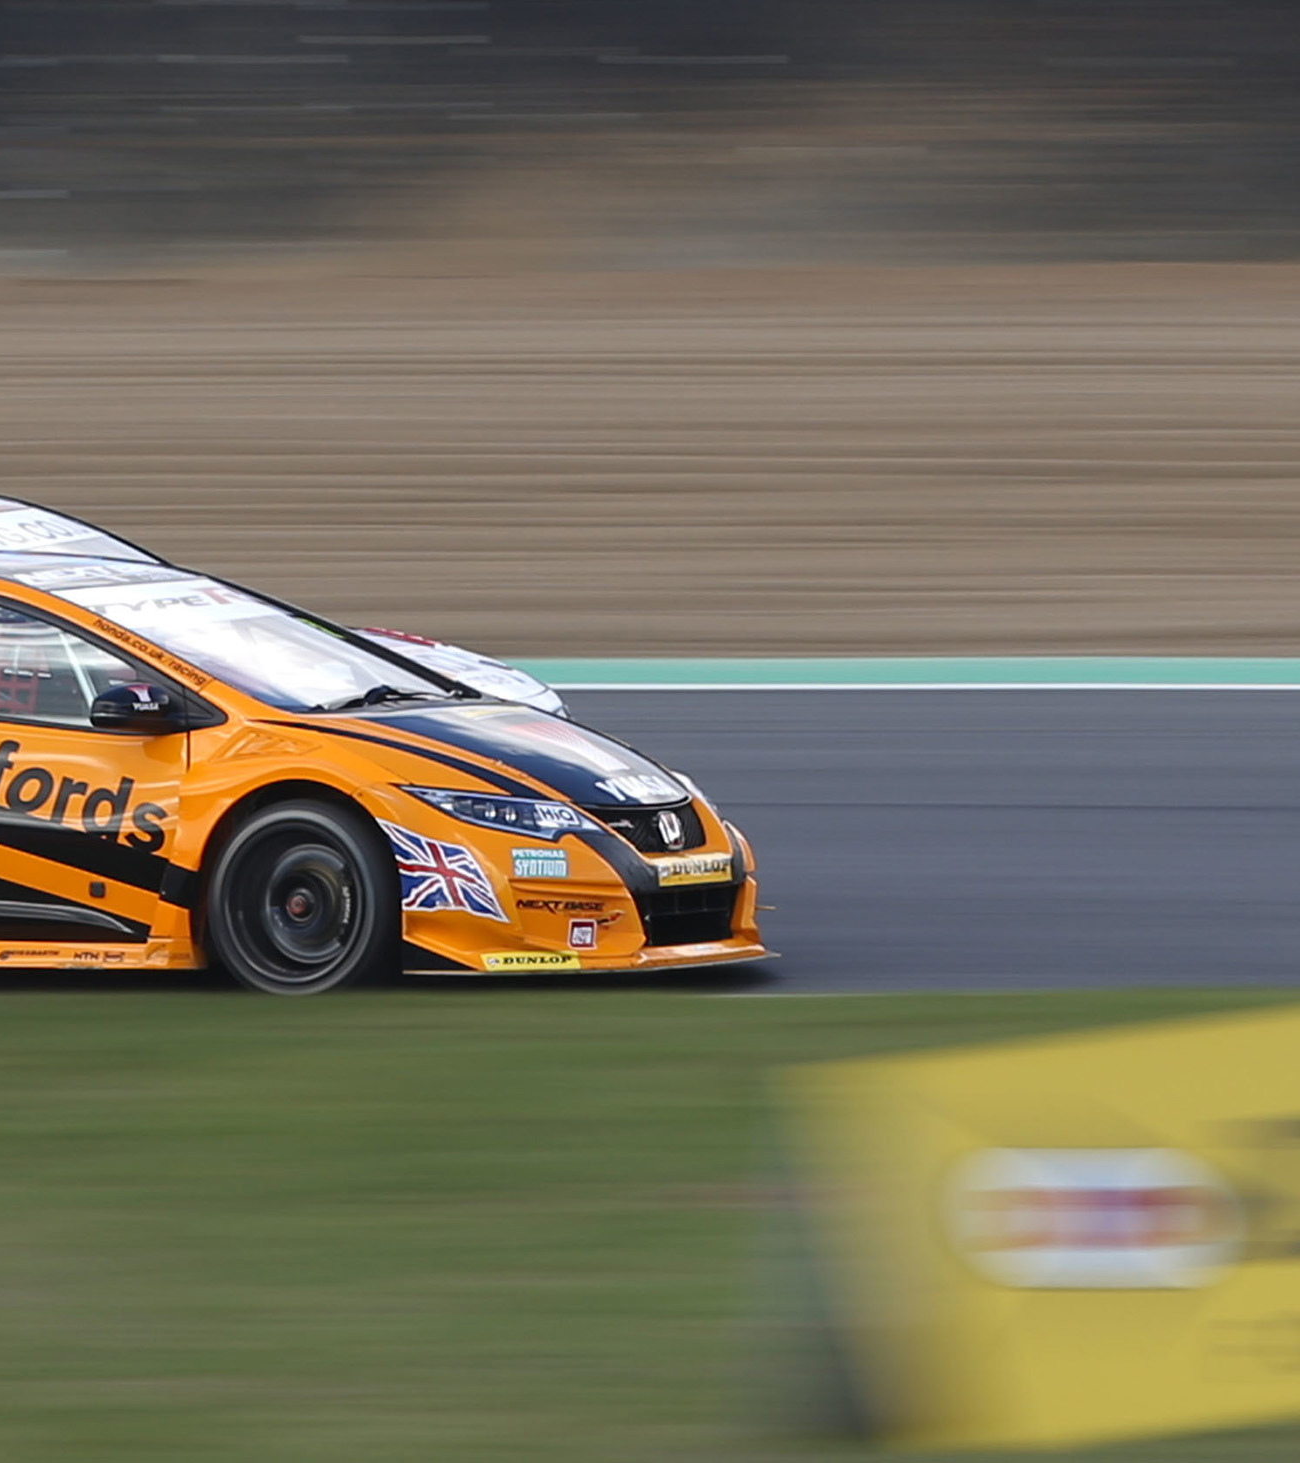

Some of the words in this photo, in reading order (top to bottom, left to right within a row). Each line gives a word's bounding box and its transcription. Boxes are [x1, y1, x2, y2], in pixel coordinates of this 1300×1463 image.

[539, 806, 575, 824] HiQ
[512, 849, 566, 859] PETRONAS
[515, 860, 568, 877] SYNTIUM
[671, 856, 730, 875] DUNLOP
[502, 955, 572, 965] DUNLOP
